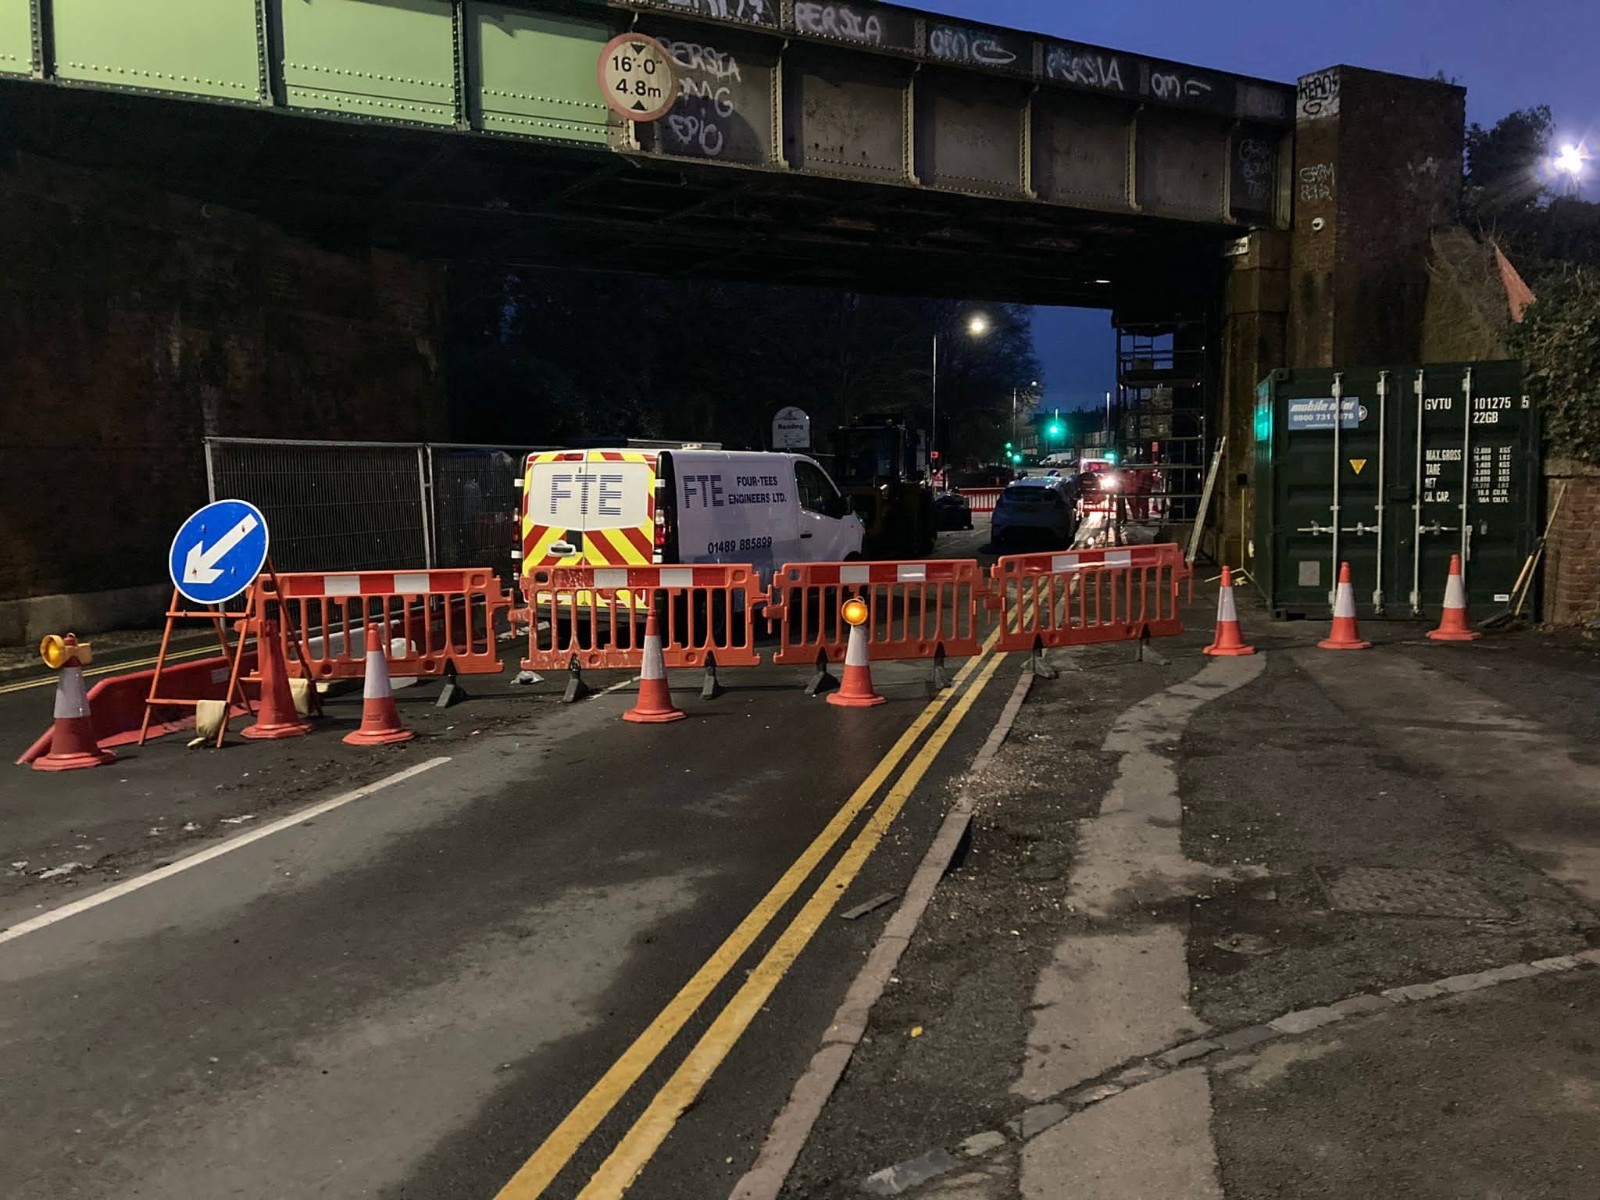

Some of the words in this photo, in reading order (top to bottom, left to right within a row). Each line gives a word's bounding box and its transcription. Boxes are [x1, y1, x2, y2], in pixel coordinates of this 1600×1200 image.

[616, 79, 661, 98] 4.8m
[1424, 398, 1452, 410] GVTU
[1474, 397, 1512, 409] 101275
[1521, 395, 1530, 408] 5
[1472, 412, 1499, 424] 22GB
[1425, 449, 1461, 461] MAX.GROSS
[1425, 464, 1441, 476] TARE
[1424, 478, 1437, 488] NET
[550, 474, 624, 516] FTE
[682, 474, 725, 509] FTE
[736, 475, 778, 488] FOUR-TEES
[728, 492, 770, 505] ENGINEERS
[772, 491, 787, 504] LTD.
[708, 540, 736, 555] 01489
[739, 536, 773, 552] 885899
